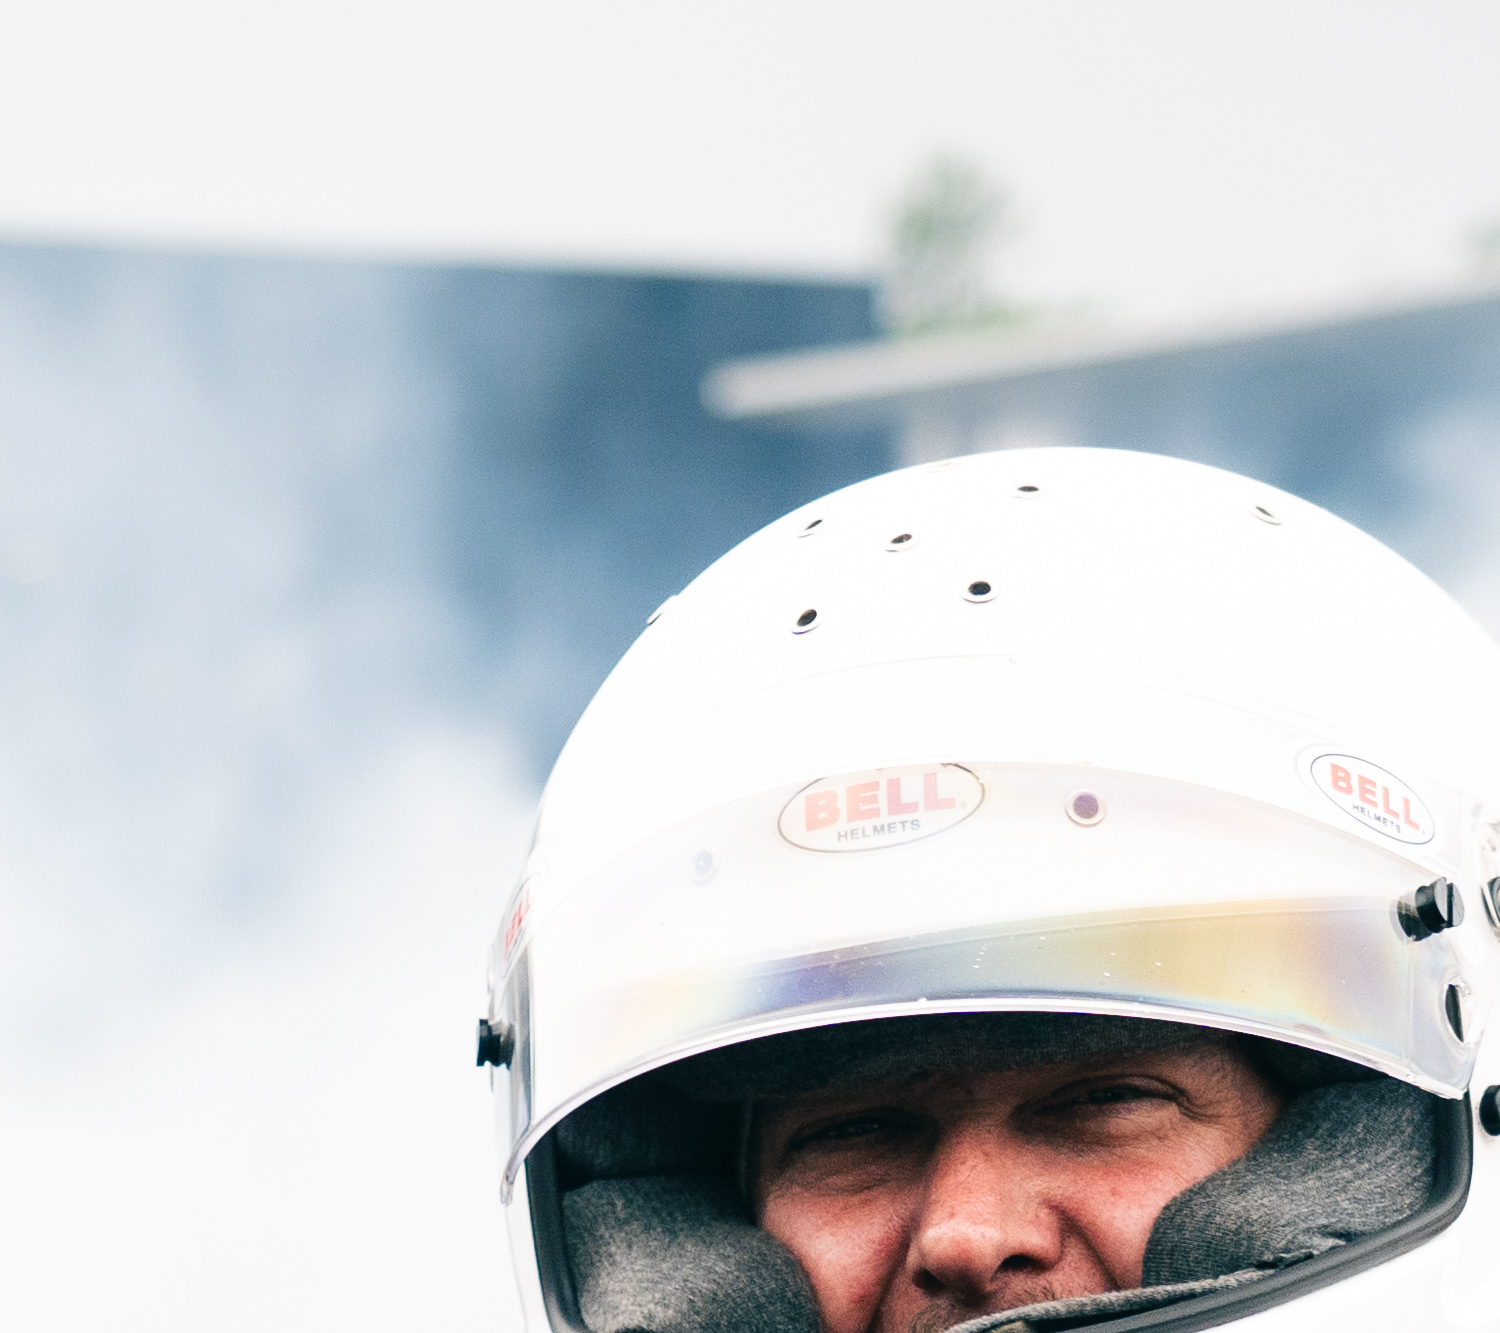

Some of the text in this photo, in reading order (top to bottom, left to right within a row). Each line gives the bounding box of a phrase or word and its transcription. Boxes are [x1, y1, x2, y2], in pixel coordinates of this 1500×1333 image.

[804, 772, 956, 832] BELL
[1329, 762, 1420, 831] BELL
[1352, 803, 1402, 833] HELMETS
[837, 819, 921, 843] HELMETS
